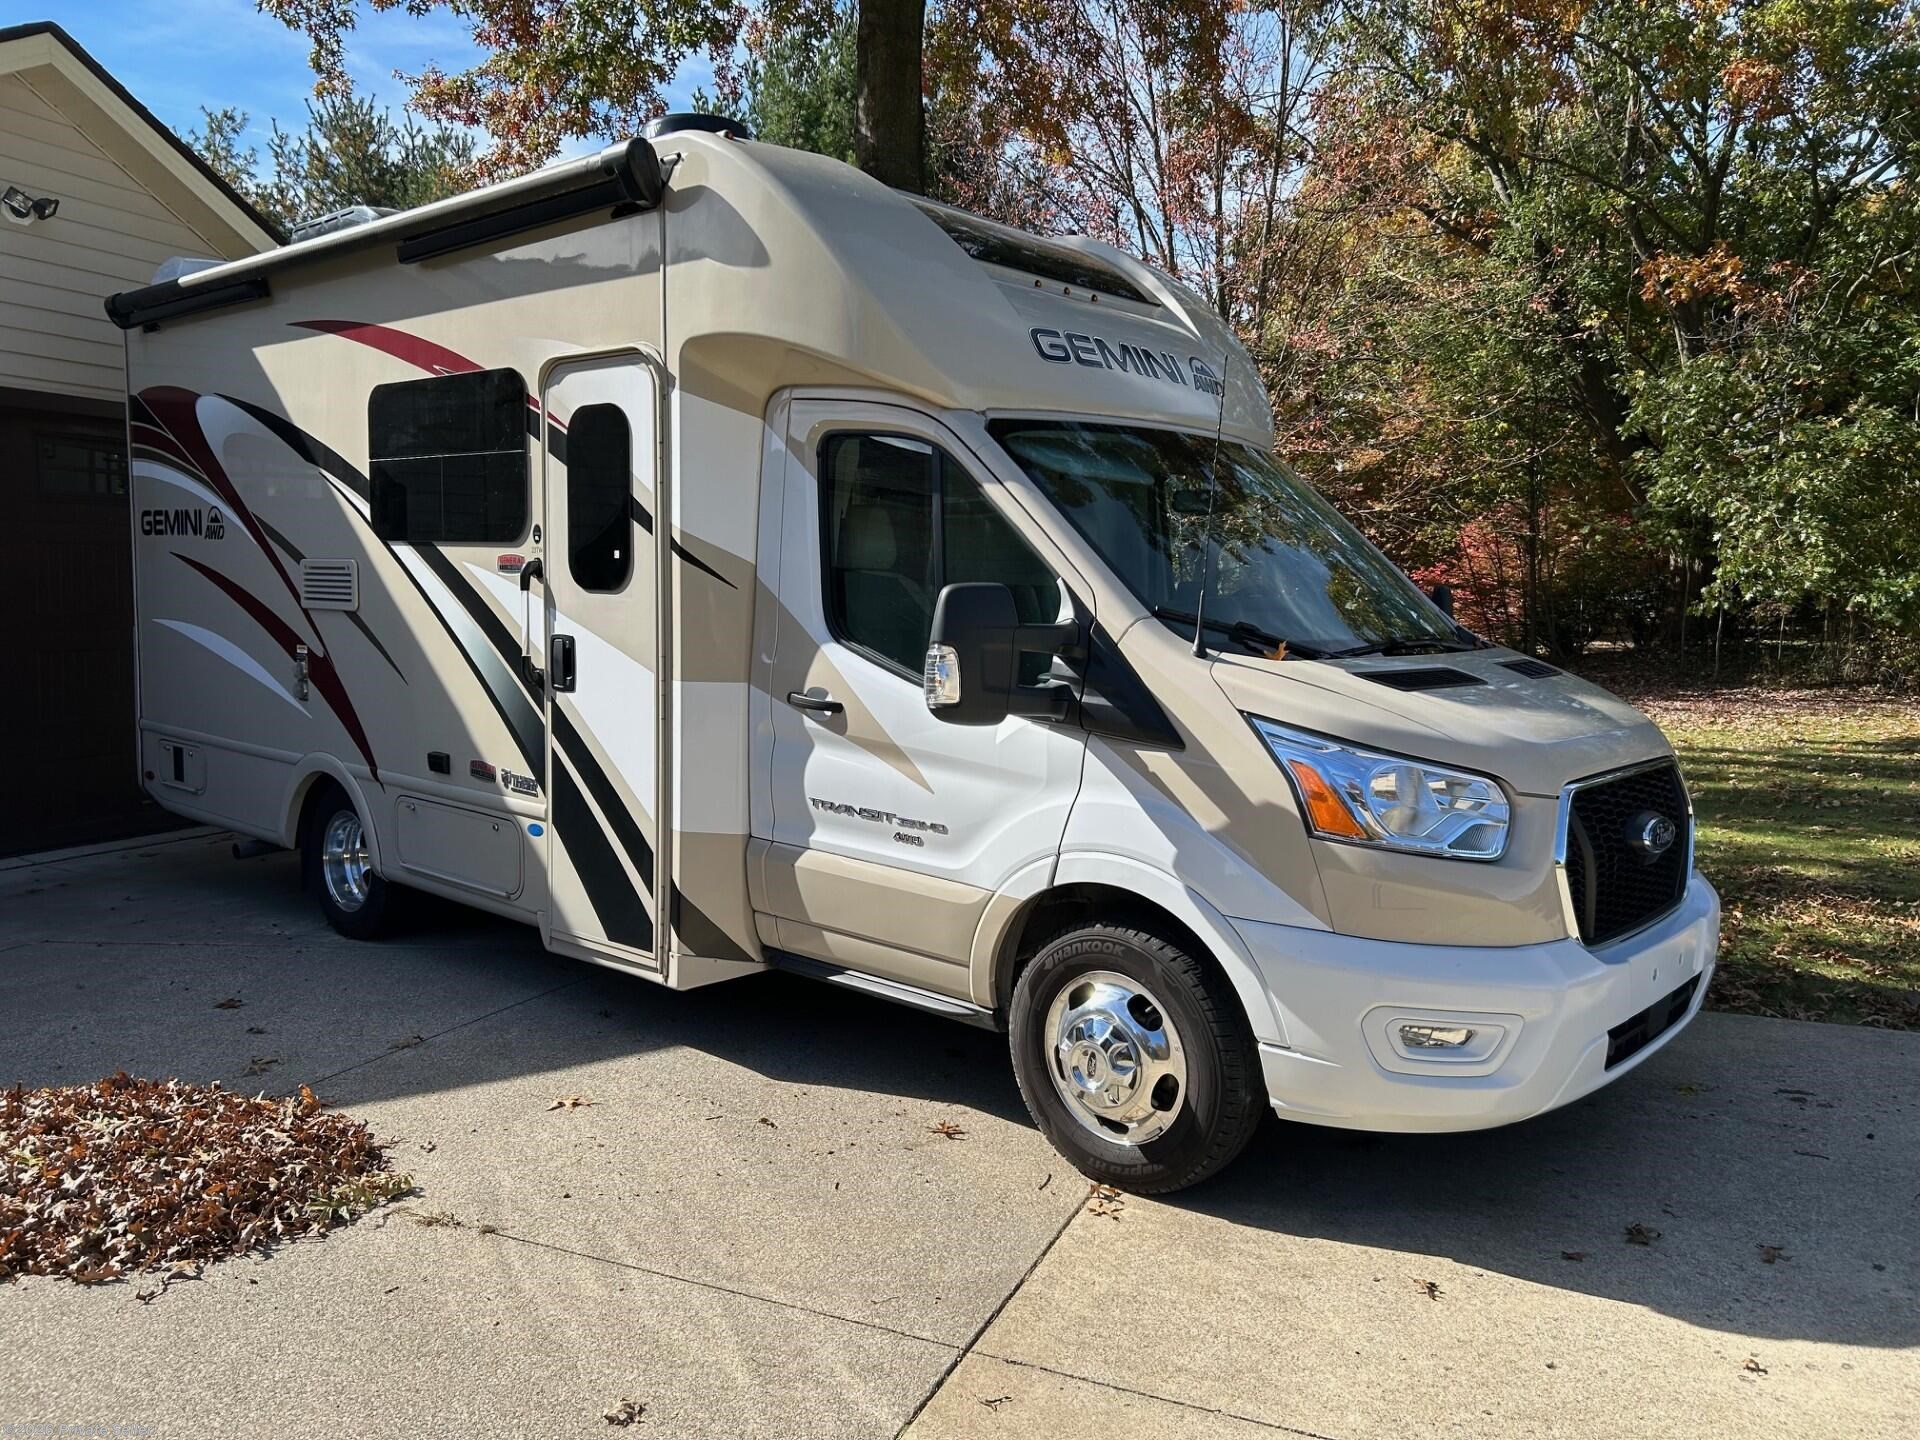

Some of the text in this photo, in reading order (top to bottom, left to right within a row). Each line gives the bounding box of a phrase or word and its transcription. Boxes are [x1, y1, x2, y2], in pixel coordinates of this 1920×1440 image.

[1029, 327, 1188, 386] GEMINI
[141, 508, 225, 540] GEMINI AWD
[808, 796, 897, 825] TRANSIT
